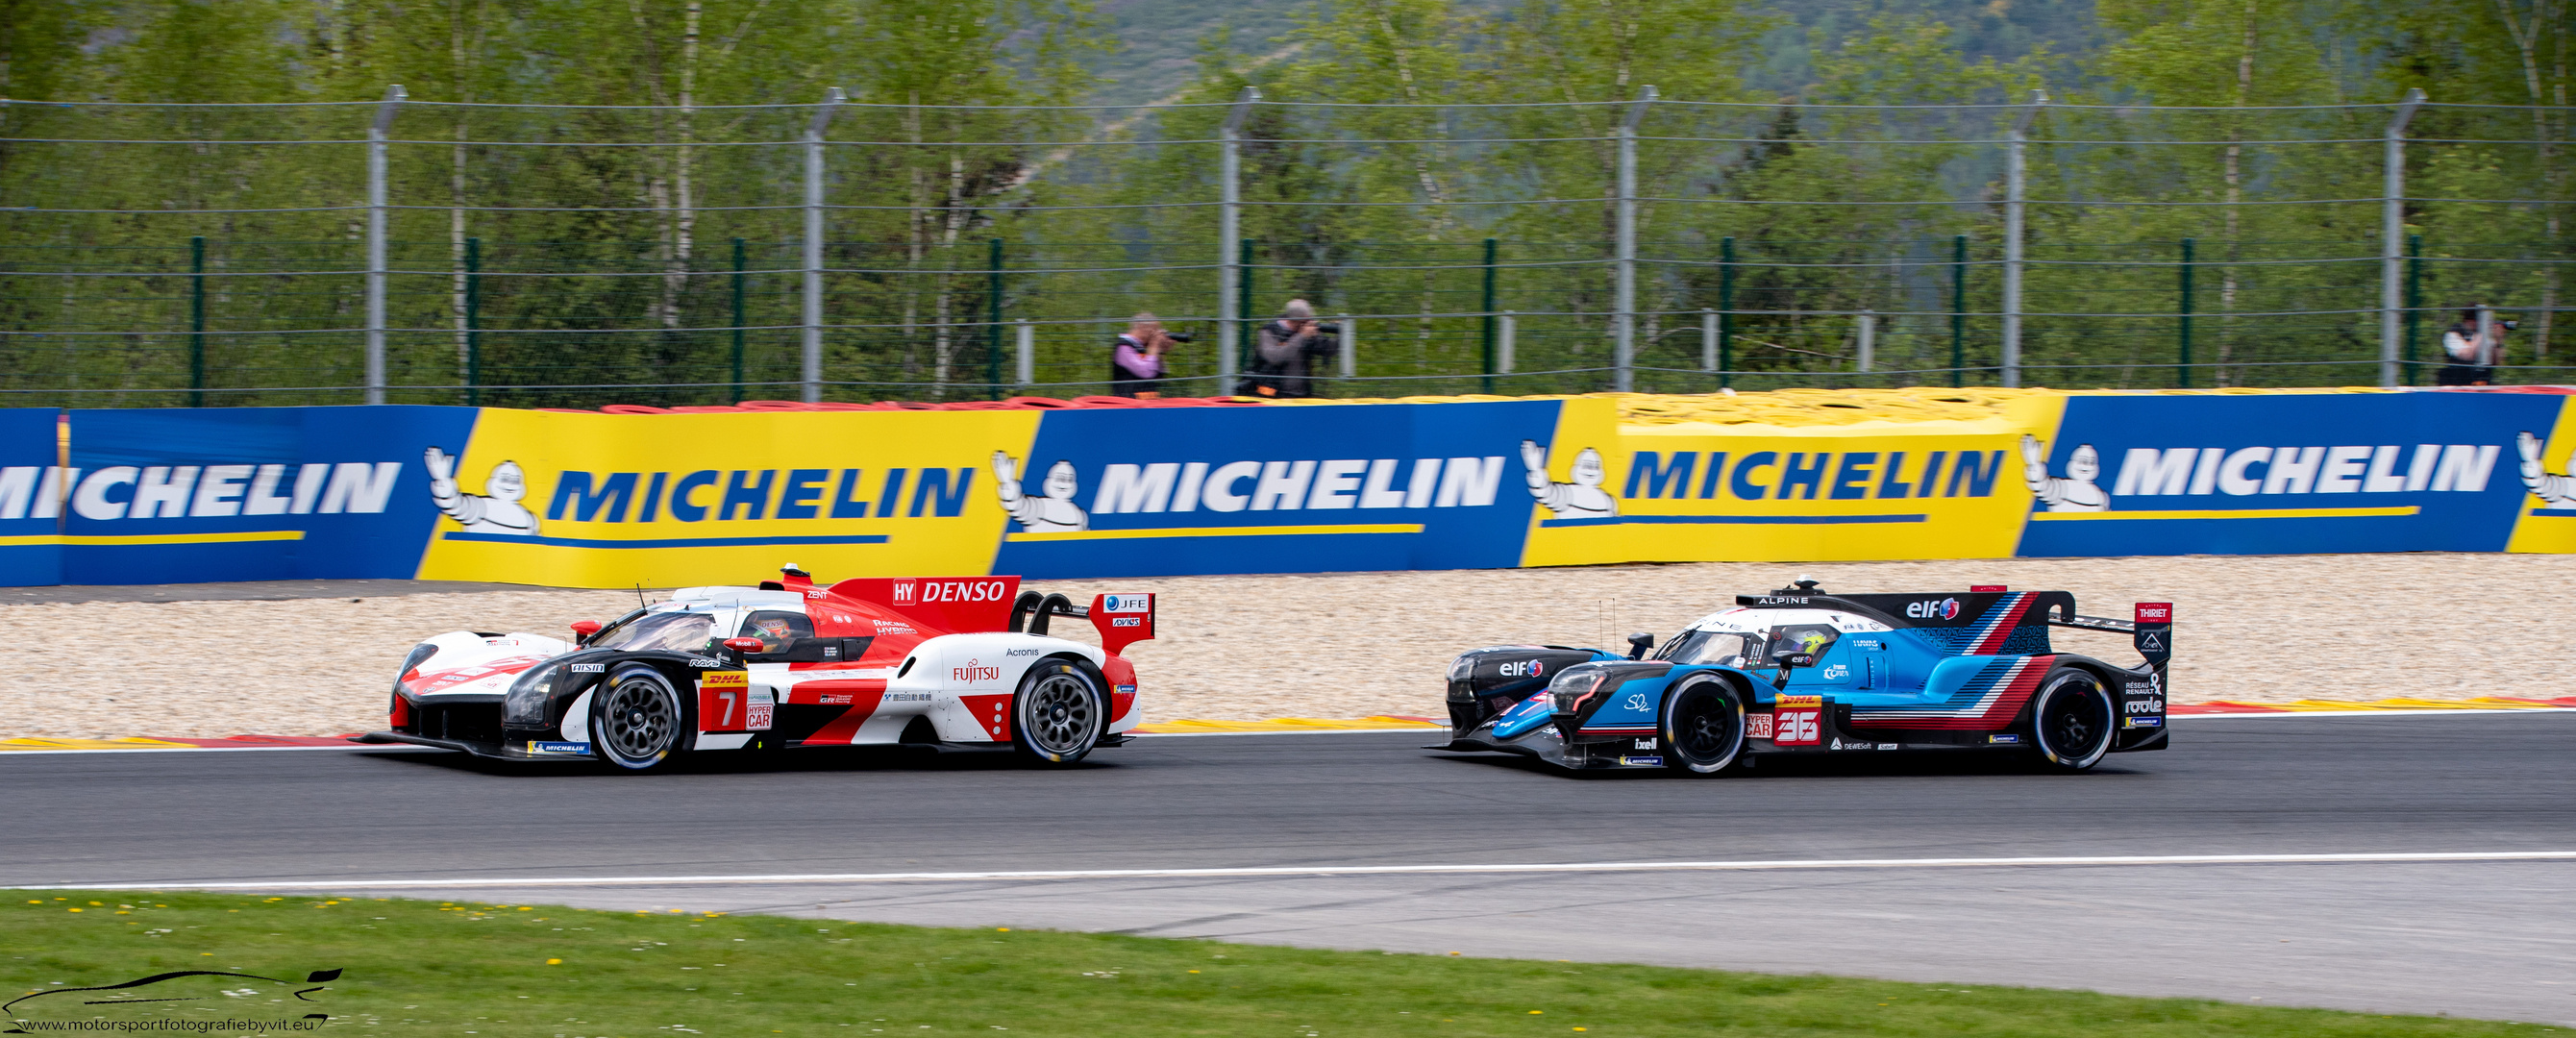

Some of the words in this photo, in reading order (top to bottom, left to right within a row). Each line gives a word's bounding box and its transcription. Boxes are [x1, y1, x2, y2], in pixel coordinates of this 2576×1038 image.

[1622, 450, 2009, 501] MICHELIN
[2113, 443, 2502, 496] MICHELIN
[1091, 456, 1506, 514] MICHELIN
[545, 467, 979, 523] MICHELIN
[807, 590, 827, 600] ZENT
[895, 583, 914, 601] HY
[922, 581, 1004, 602] DENSO
[1120, 600, 1146, 608] JFE
[1906, 601, 1940, 619] elf
[2140, 608, 2167, 618] THIRIET
[872, 619, 909, 629] RACING
[877, 627, 918, 635] HYBRID
[1006, 648, 1039, 657] Acronis
[688, 658, 721, 667] RAYS
[1499, 660, 1527, 677] elf
[708, 675, 743, 683] DHL
[953, 663, 1000, 684] FUJITSU
[2125, 680, 2149, 689] RÉSEAU
[1782, 696, 1816, 704] DHL
[2125, 696, 2163, 713] roole
[719, 692, 737, 727] 7
[748, 705, 772, 715] HYPER
[748, 714, 771, 728] CAR
[1776, 711, 1819, 742] 36
[1746, 723, 1771, 736] CAR
[1634, 737, 1657, 750] ixell
